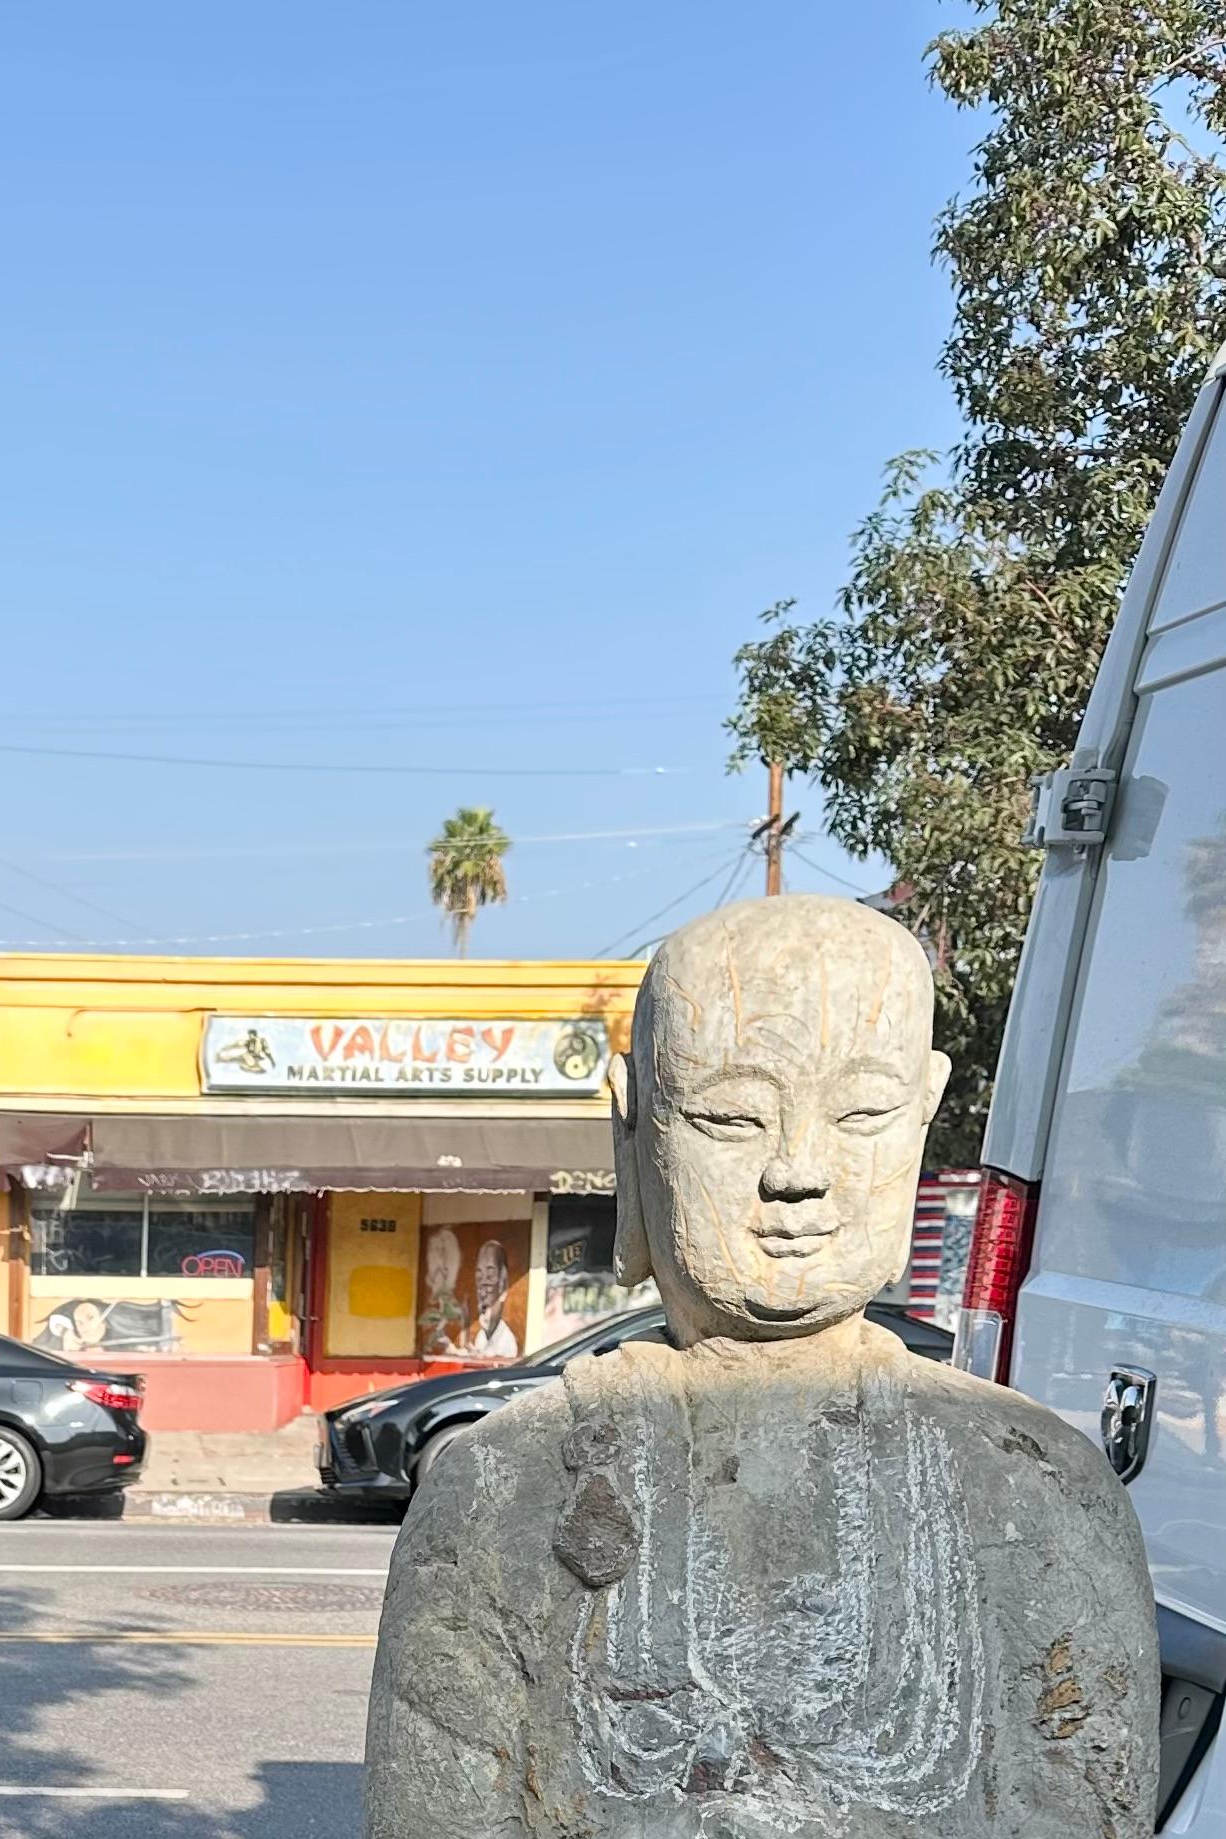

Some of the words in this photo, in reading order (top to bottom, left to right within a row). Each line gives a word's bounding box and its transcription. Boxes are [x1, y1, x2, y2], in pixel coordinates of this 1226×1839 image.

[310, 1023, 515, 1064] VALLEY
[287, 1065, 385, 1083] MARTIAL
[395, 1065, 452, 1083] ARTS
[462, 1067, 544, 1084] SUPPLY
[181, 1256, 242, 1278] OPEN
